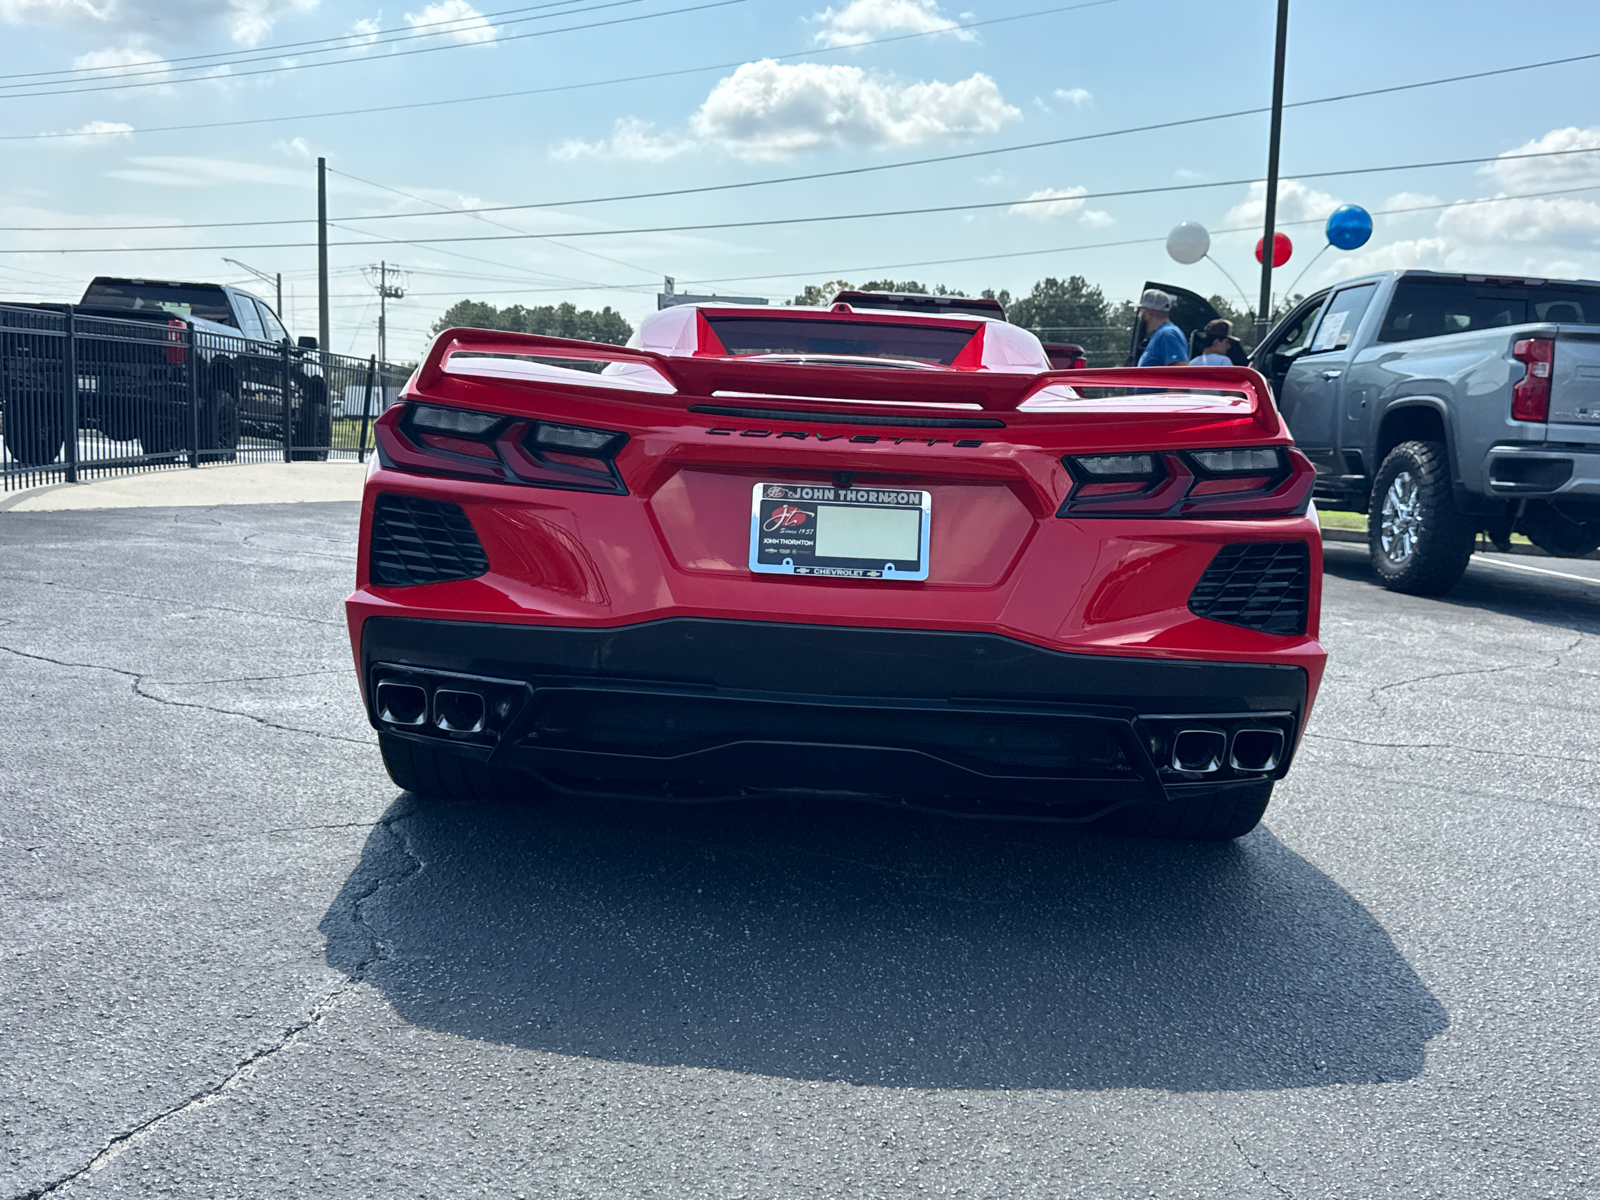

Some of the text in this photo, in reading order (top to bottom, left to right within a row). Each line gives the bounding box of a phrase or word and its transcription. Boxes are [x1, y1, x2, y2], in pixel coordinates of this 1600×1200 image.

[705, 427, 984, 448] CORVETTE
[794, 488, 920, 505] JOHN THORNTON
[780, 527, 815, 536] Since 1957
[763, 537, 814, 546] JOHN THORNTON
[813, 567, 864, 577] CHEVROLET
